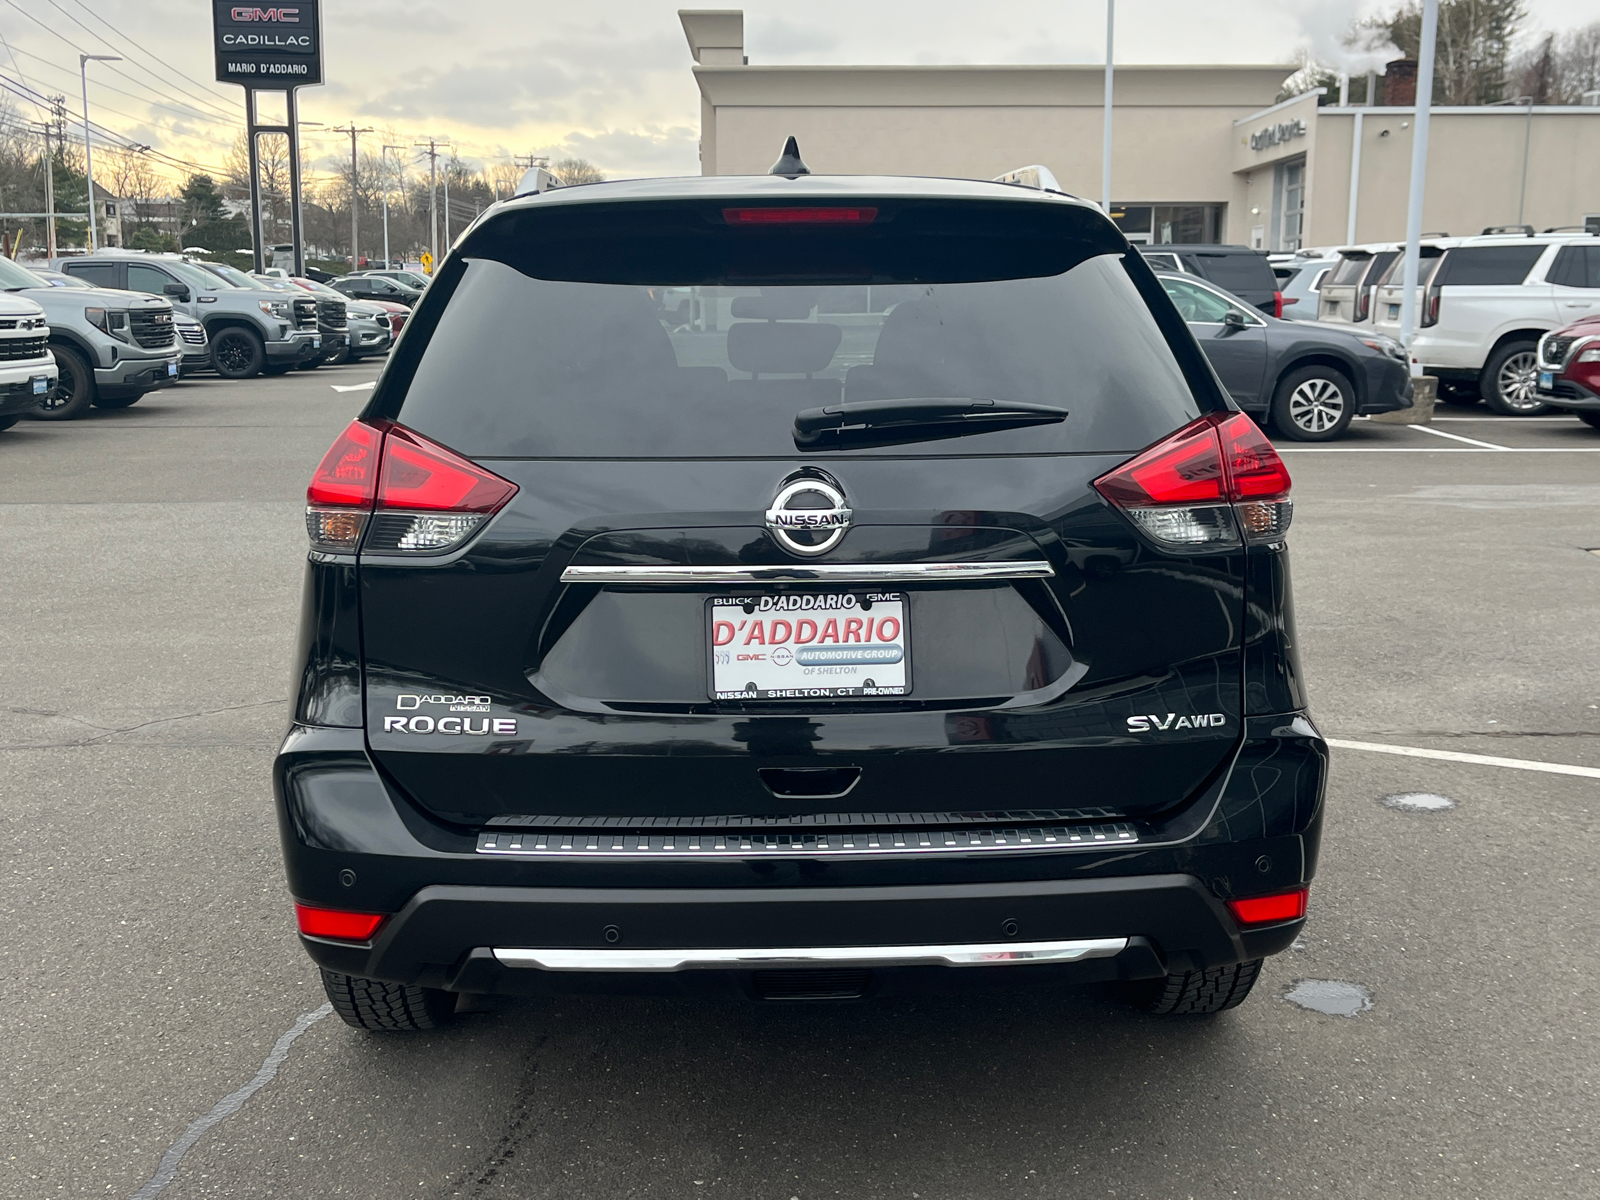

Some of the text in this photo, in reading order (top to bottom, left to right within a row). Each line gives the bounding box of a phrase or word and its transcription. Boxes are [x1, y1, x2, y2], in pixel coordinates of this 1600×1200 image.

[231, 7, 299, 22] GMC
[223, 34, 310, 46] CADILLAC
[228, 62, 308, 74] MARIO D'ADDARIO
[775, 514, 844, 526] NISSAN
[714, 593, 900, 611] BUICK D'ADDARIO GMC
[713, 616, 900, 646] D'ADDARIO
[801, 649, 898, 660] AUTOMOTIVE GROUP
[803, 666, 858, 675] OF SHELTON
[716, 687, 904, 700] NISSAN SHELTON, CT PRE-OWNED
[384, 716, 517, 735] ROGUE
[1126, 713, 1226, 733] SV AWD
